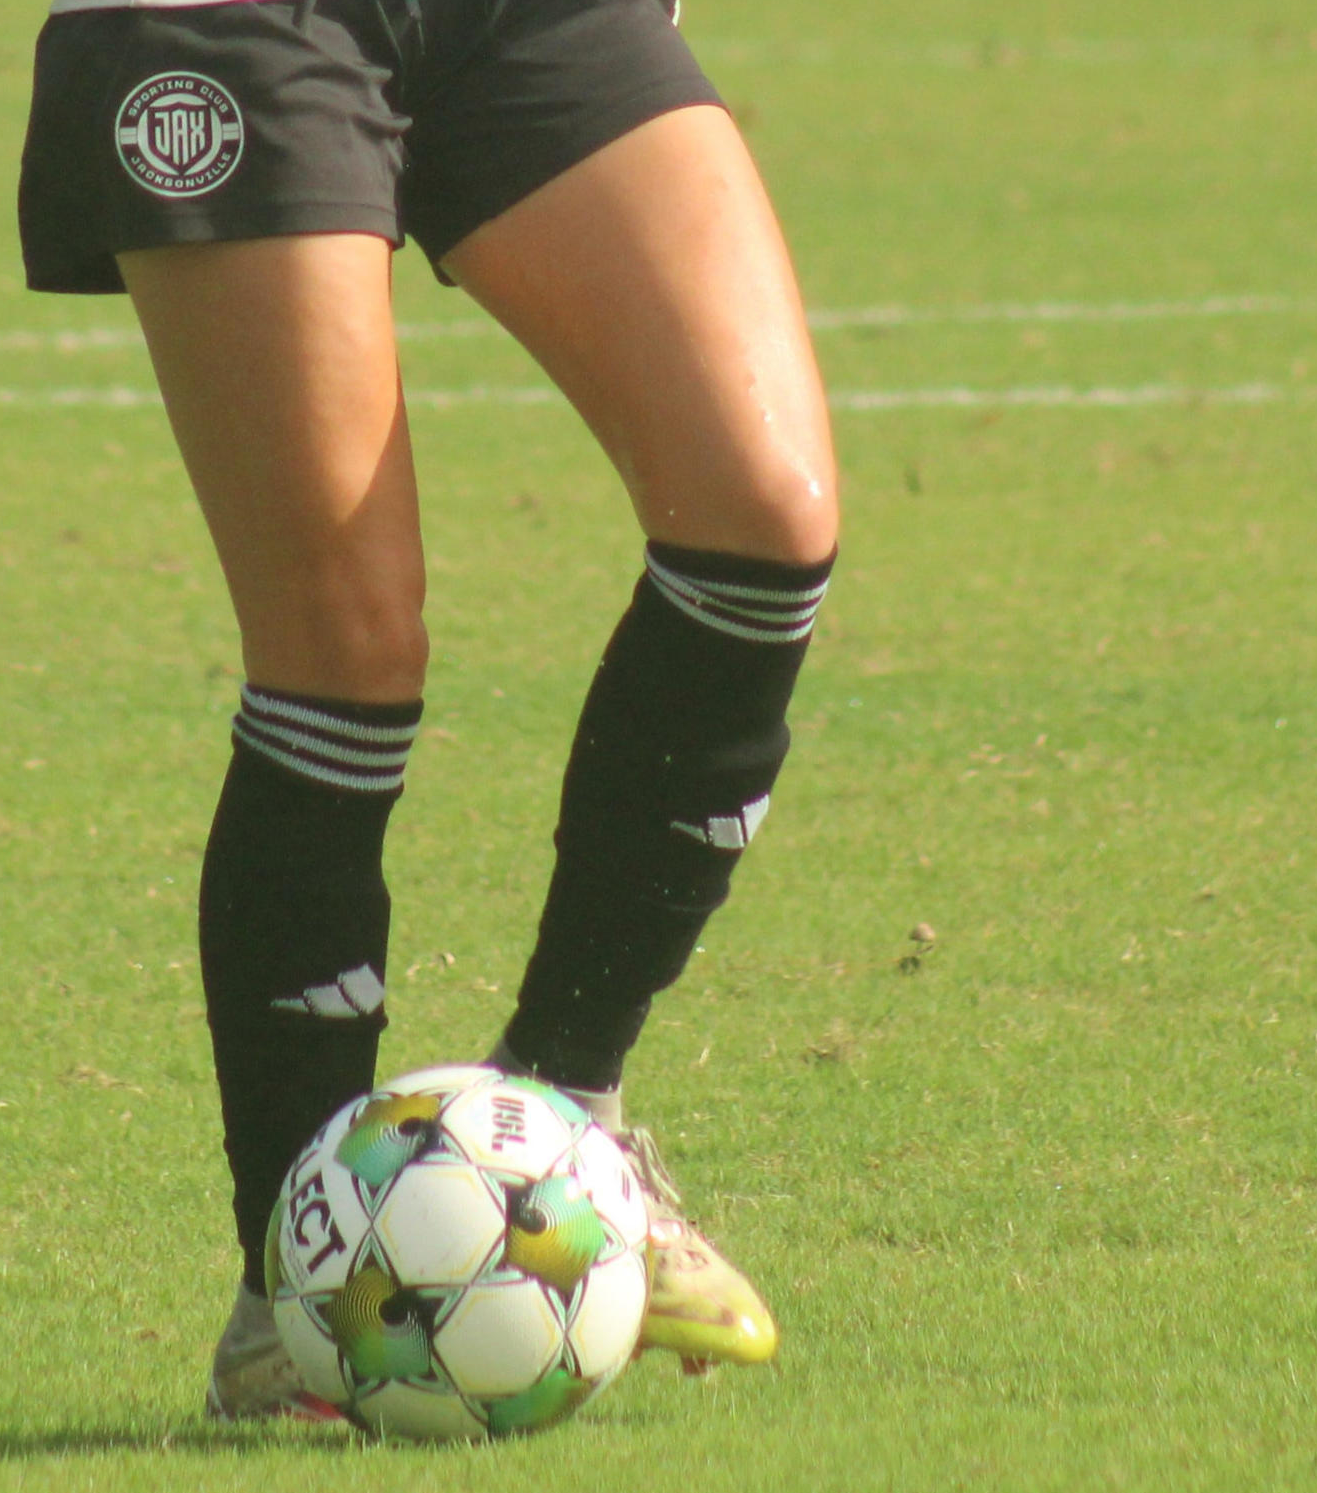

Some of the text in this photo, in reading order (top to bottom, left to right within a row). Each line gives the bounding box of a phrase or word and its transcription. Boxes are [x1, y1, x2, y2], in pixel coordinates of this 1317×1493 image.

[128, 80, 229, 117] SPORTING CLUB
[154, 109, 206, 165] JAX
[130, 151, 232, 189] JACKSONVILLE
[491, 1096, 527, 1152] USL
